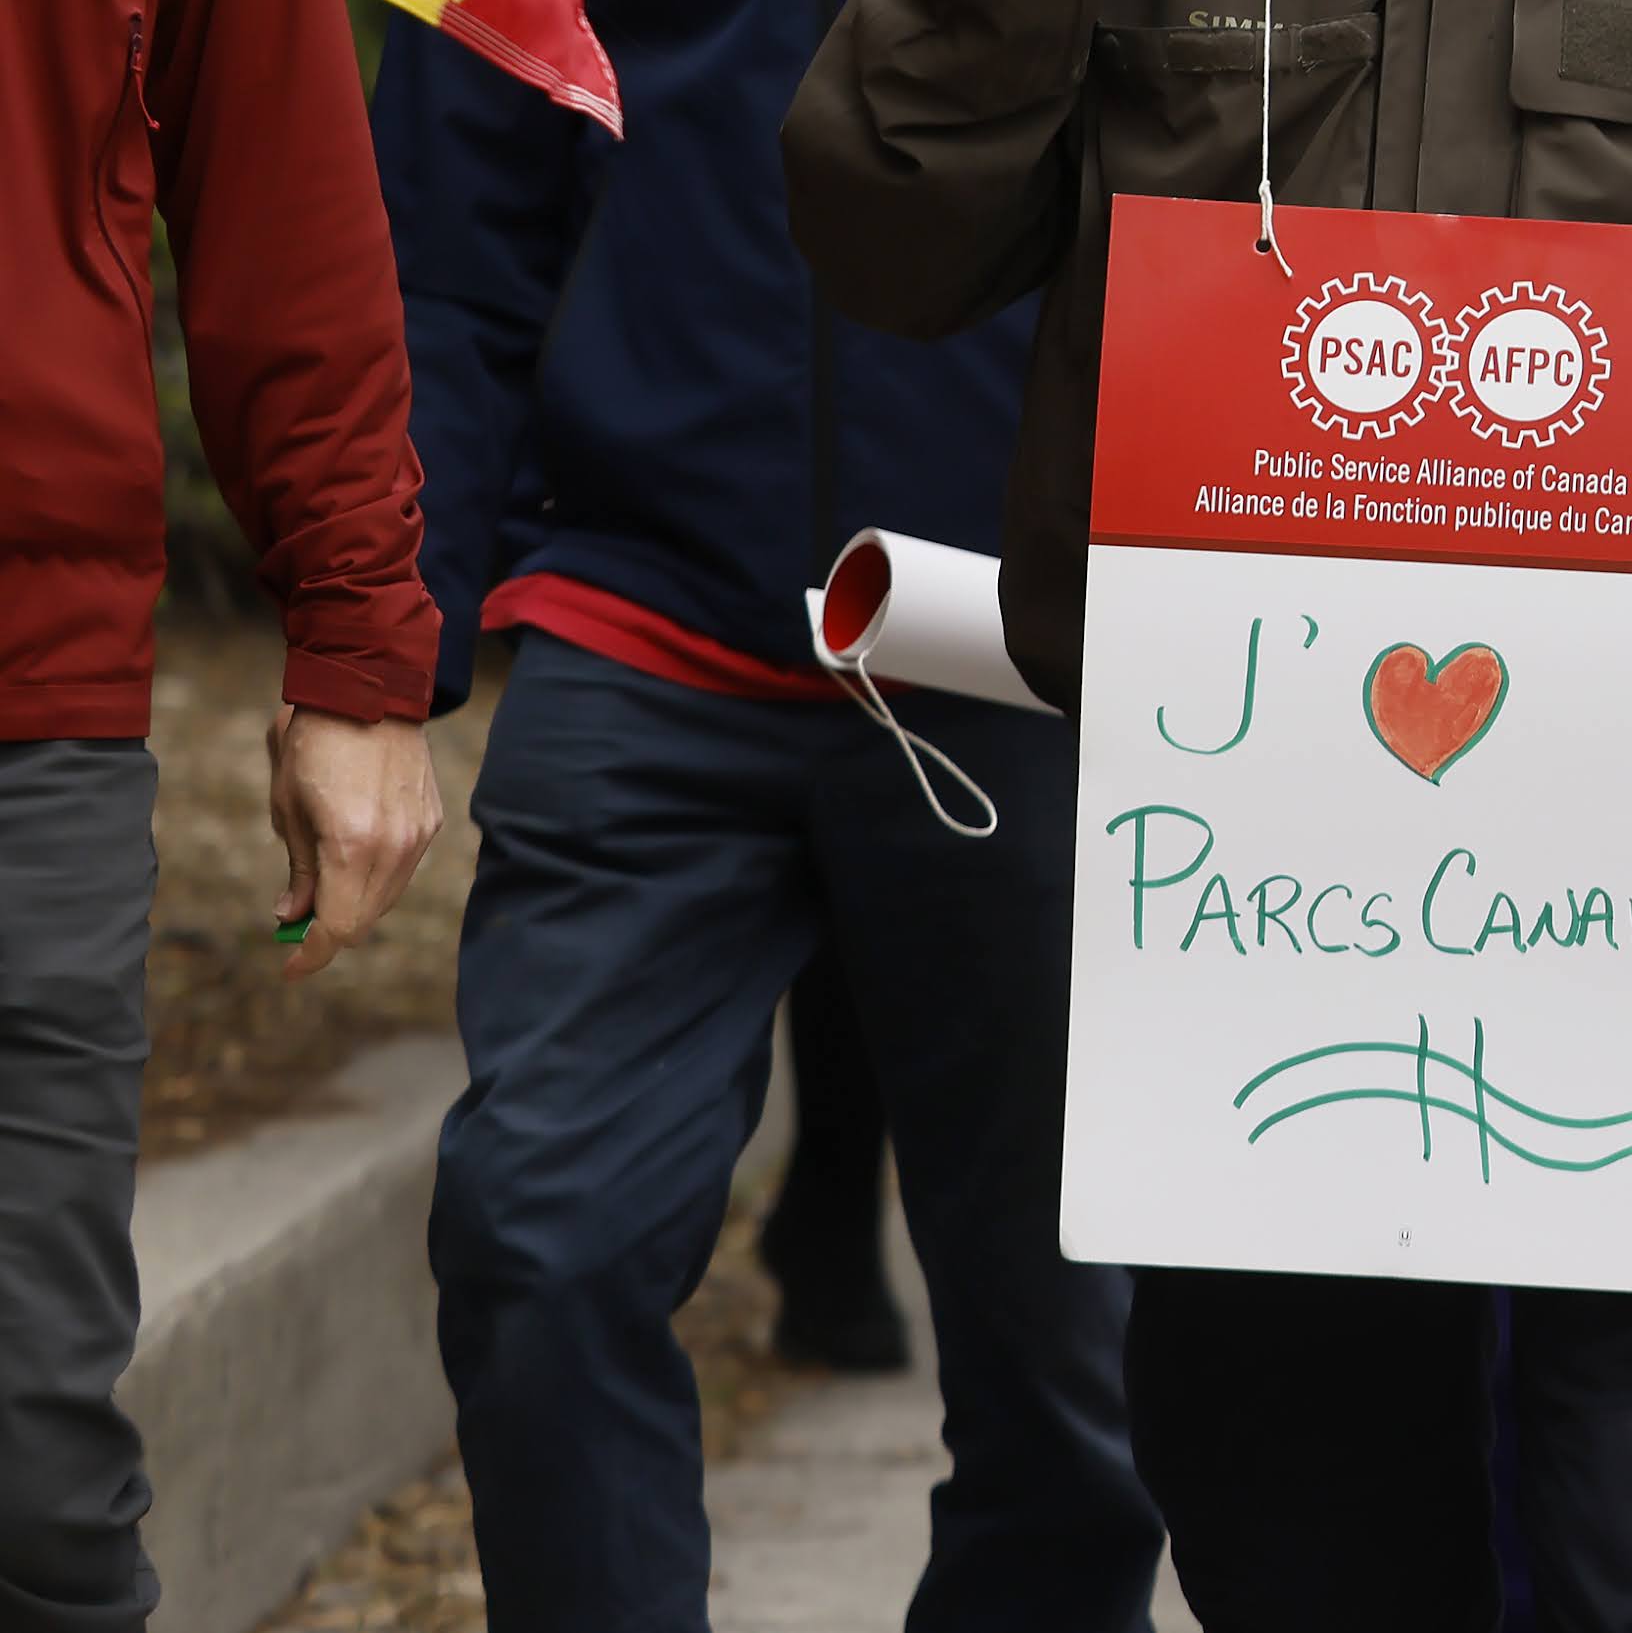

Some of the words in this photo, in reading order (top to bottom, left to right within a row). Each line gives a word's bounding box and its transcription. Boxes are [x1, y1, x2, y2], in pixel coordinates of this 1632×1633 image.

[1318, 335, 1414, 379] PSAC
[1479, 345, 1576, 389] AFPC
[1254, 449, 1323, 479] Public
[1330, 454, 1410, 485] Service
[1416, 458, 1506, 490] Alliance
[1512, 463, 1536, 490] of
[1540, 465, 1629, 496] Canada
[1194, 485, 1285, 517] Alliance
[1291, 490, 1319, 519] de
[1325, 492, 1346, 521] la
[1353, 494, 1447, 526] Fonction
[1454, 499, 1552, 536] publique
[1558, 505, 1588, 533] du
[1156, 613, 1319, 756] J'
